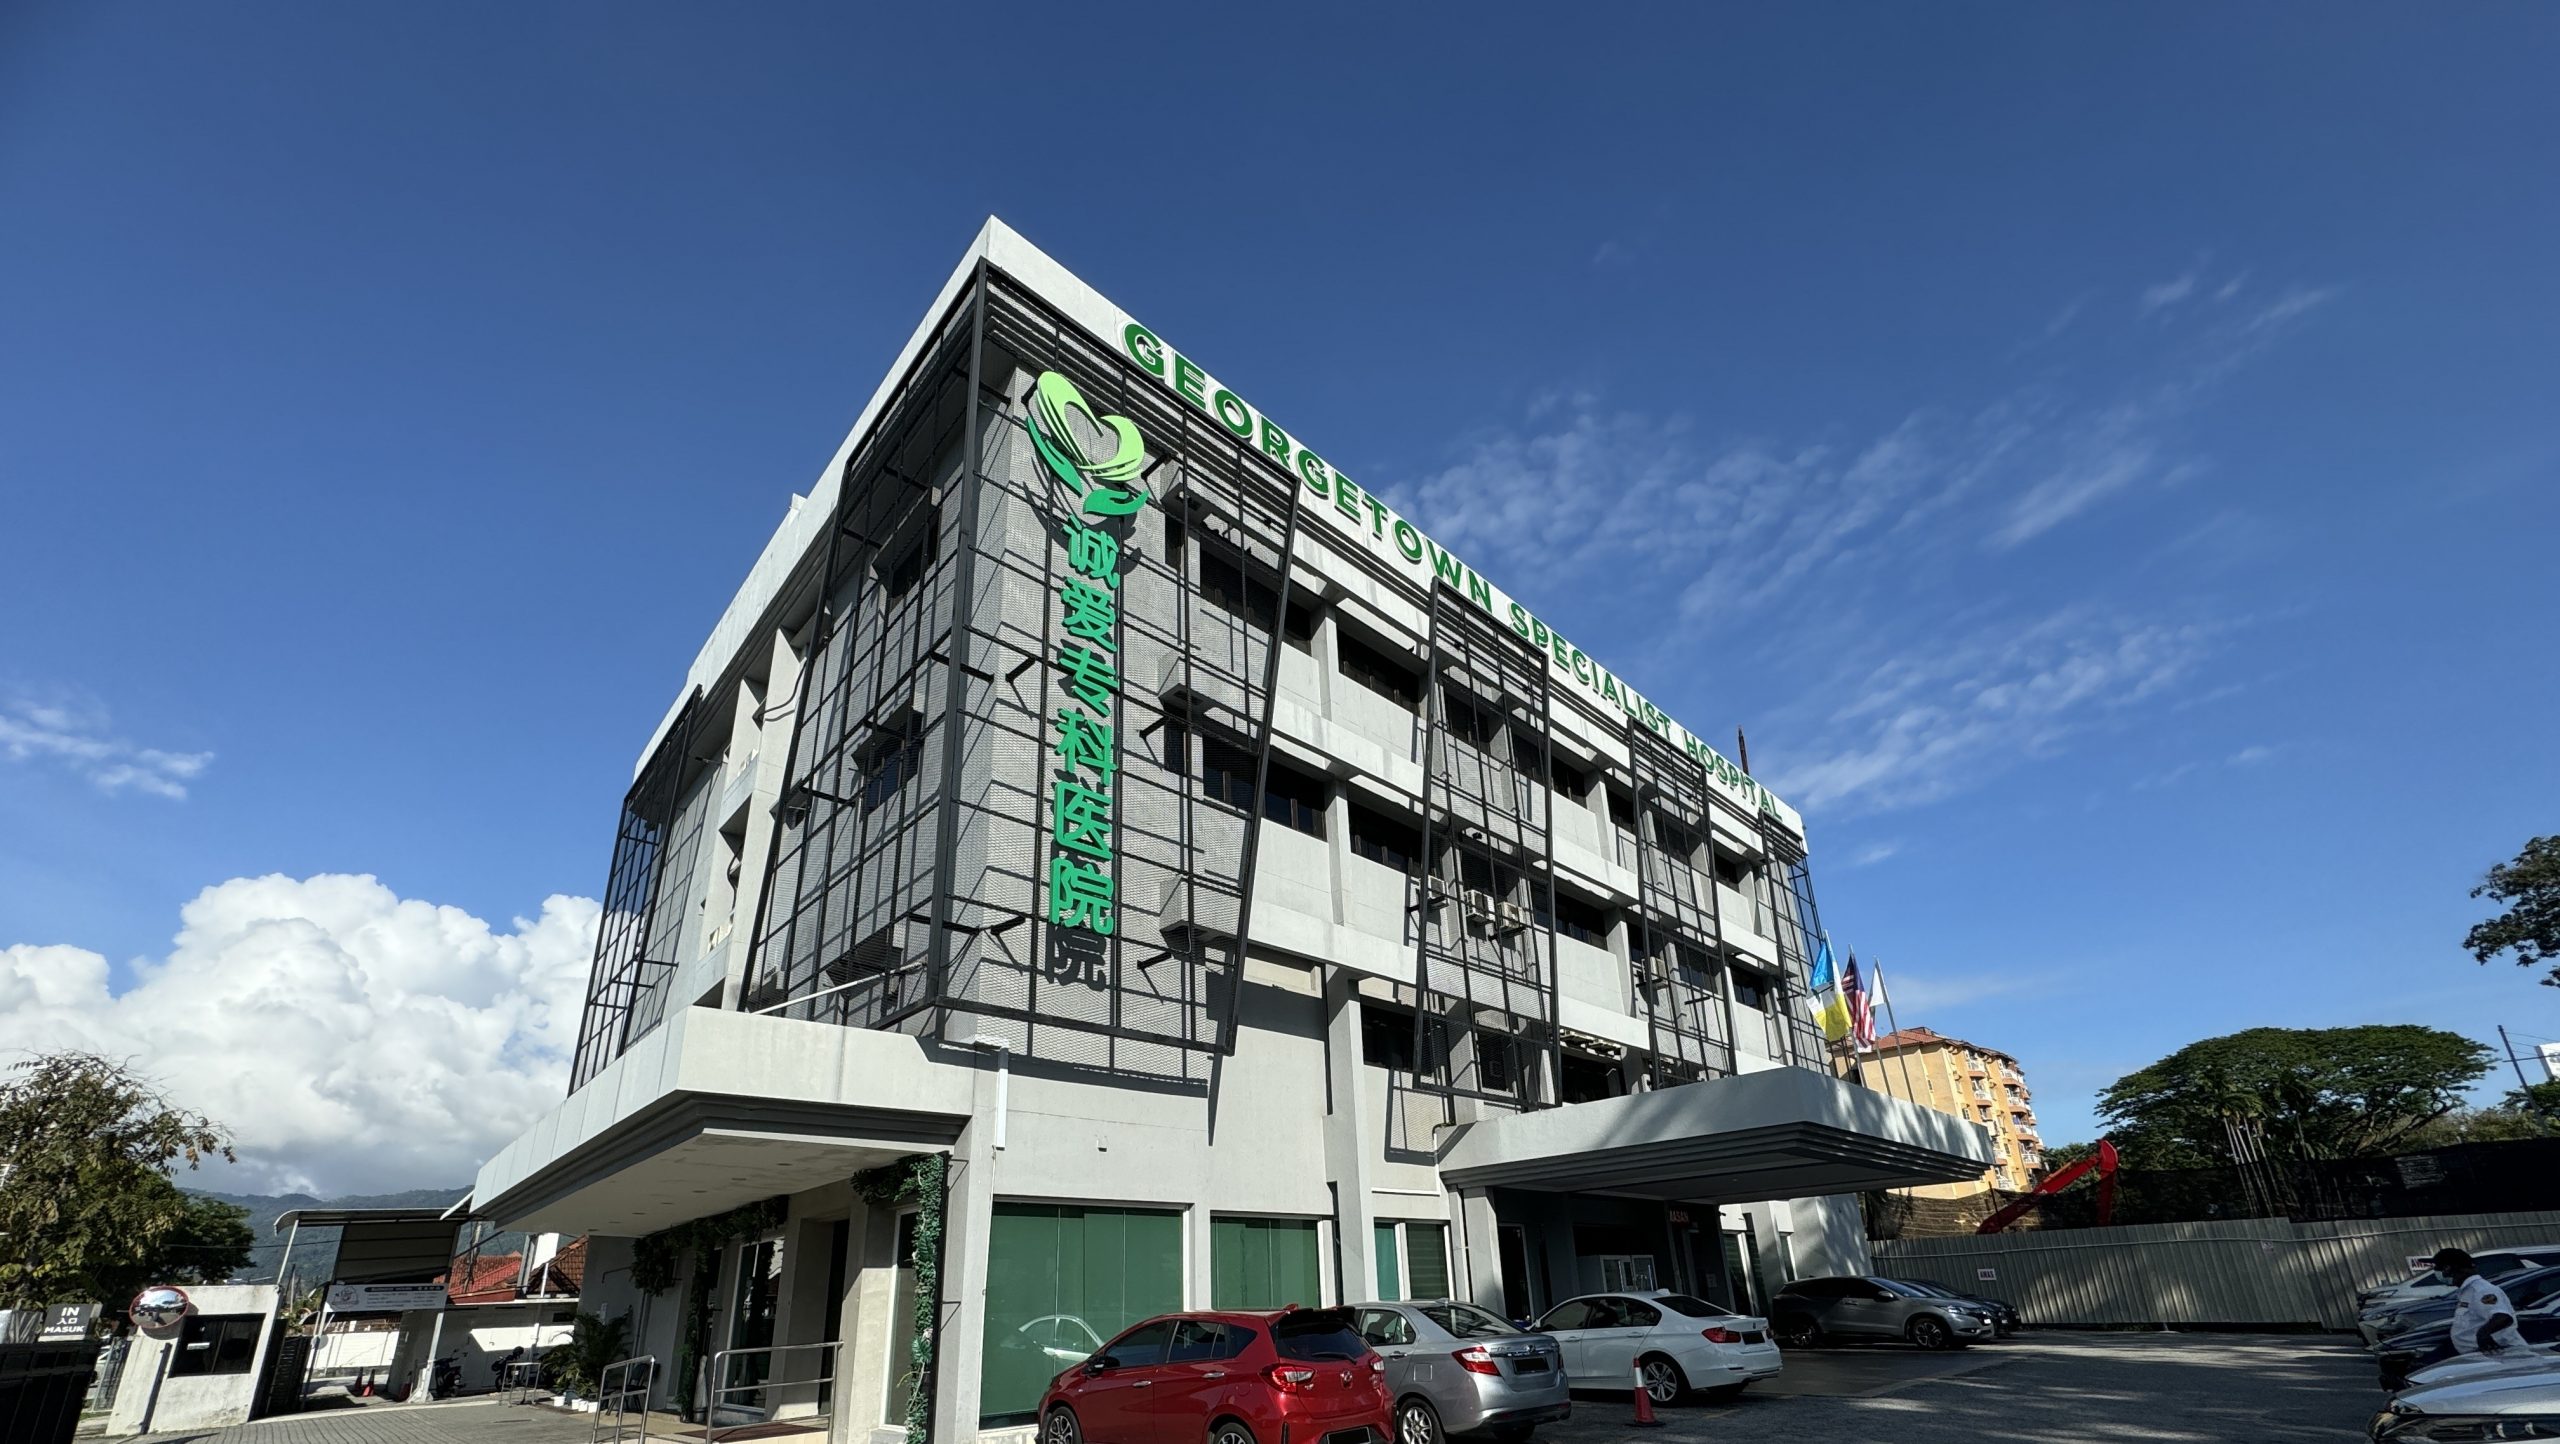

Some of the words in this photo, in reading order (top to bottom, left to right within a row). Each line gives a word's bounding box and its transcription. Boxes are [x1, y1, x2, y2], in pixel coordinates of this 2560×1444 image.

[1122, 322, 1493, 614] GEORGETOWN
[1508, 602, 1672, 743] SPECIALIST
[1682, 729, 1784, 823] HOSPITAL
[1048, 515, 1121, 936] 诚爱专科医院
[61, 1306, 80, 1316] IN
[56, 1317, 78, 1325] 入口
[44, 1325, 86, 1333] MASUK
